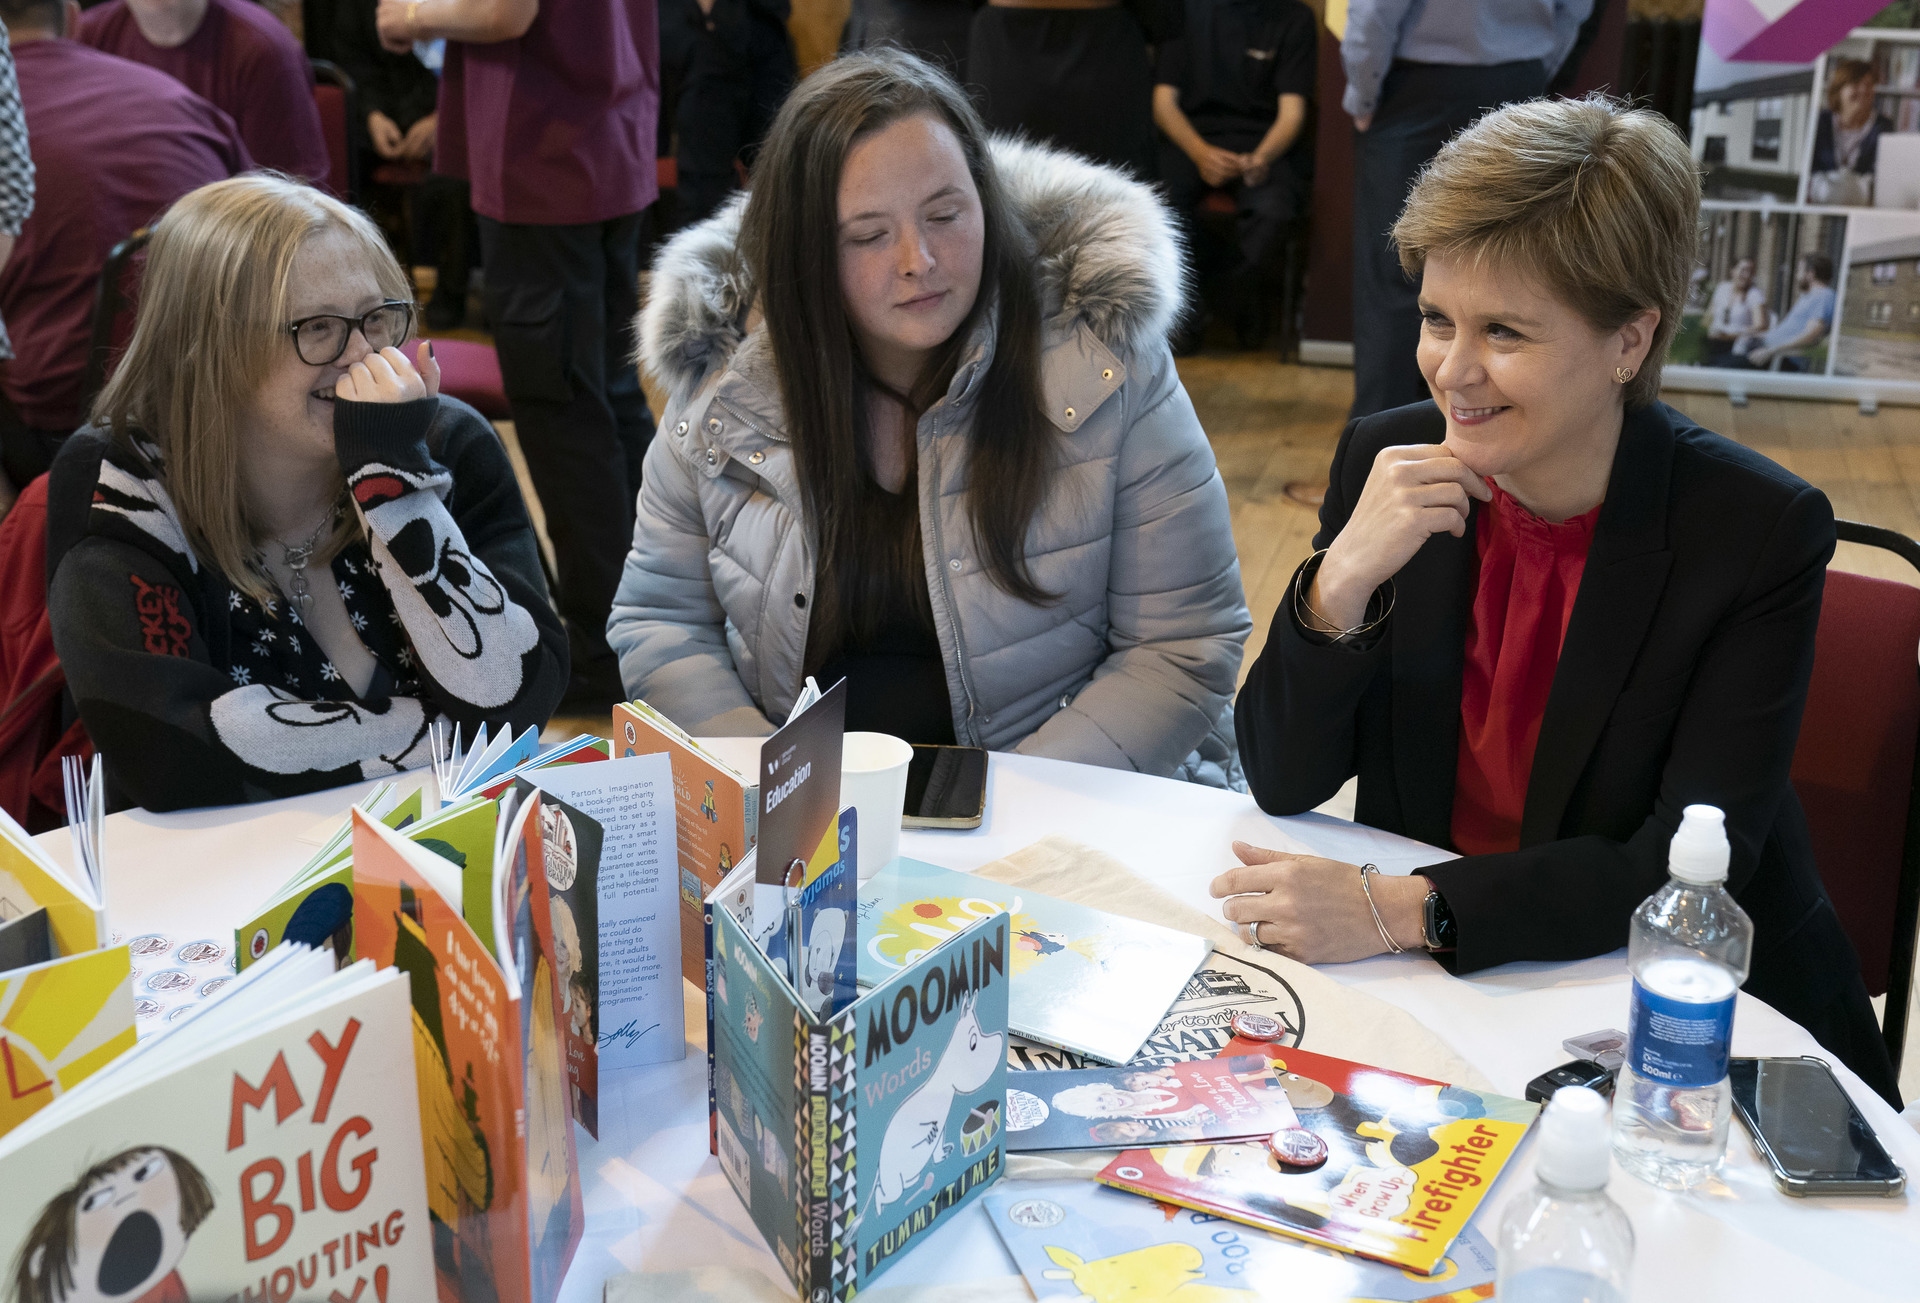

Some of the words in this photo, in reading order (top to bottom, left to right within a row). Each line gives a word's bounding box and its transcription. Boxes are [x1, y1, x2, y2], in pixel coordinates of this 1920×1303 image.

[130, 575, 168, 655] CKEY
[571, 787, 602, 798] Parton's
[609, 781, 653, 793] Imagination
[673, 785, 691, 801] ORLD
[766, 762, 811, 814] Education
[586, 795, 630, 806] book-gifting
[631, 791, 655, 800] charity
[586, 806, 615, 816] children
[619, 803, 638, 812] aged
[646, 811, 656, 819] up
[610, 823, 636, 833] Library
[604, 834, 625, 843] ather,
[636, 830, 657, 838] smart
[621, 842, 637, 850] man
[642, 839, 658, 847] who
[606, 853, 623, 861] read
[637, 850, 658, 859] write.
[600, 862, 635, 873] guarantee
[635, 858, 659, 867] access
[628, 867, 659, 878] life-long
[601, 882, 615, 891] and
[616, 880, 632, 889] help
[632, 876, 659, 886] children
[798, 859, 845, 910] yjamas
[604, 891, 617, 900] full
[623, 885, 660, 898] potential.
[598, 920, 617, 929] otally
[619, 913, 656, 926] convinced
[610, 928, 630, 937] could
[632, 926, 642, 934] do
[599, 941, 613, 950] ple
[614, 937, 634, 947] thing
[600, 950, 609, 958] ds
[611, 948, 625, 957] and
[626, 944, 649, 954] adults
[599, 960, 613, 968] ore,
[615, 958, 620, 966] it
[622, 955, 645, 965] would
[646, 953, 656, 961] be
[599, 970, 611, 978] em
[613, 967, 621, 975] to
[622, 965, 640, 974] read
[641, 963, 663, 972] more.
[599, 978, 611, 987] for
[612, 976, 629, 987] your
[631, 973, 659, 984] interest
[599, 985, 643, 997] Imagination
[865, 924, 1004, 1069] MOOMIN
[810, 1032, 828, 1092] MOOMIN
[864, 1047, 932, 1108] Words
[1642, 1063, 1671, 1079] 500ml
[226, 1016, 363, 1153] MY
[239, 1115, 378, 1263] BIG
[1403, 1123, 1499, 1243] Firefighter
[1338, 1181, 1371, 1208] When
[1359, 1191, 1393, 1218] Grow
[812, 1201, 829, 1257] Words
[228, 1209, 405, 1303] HOUTING
